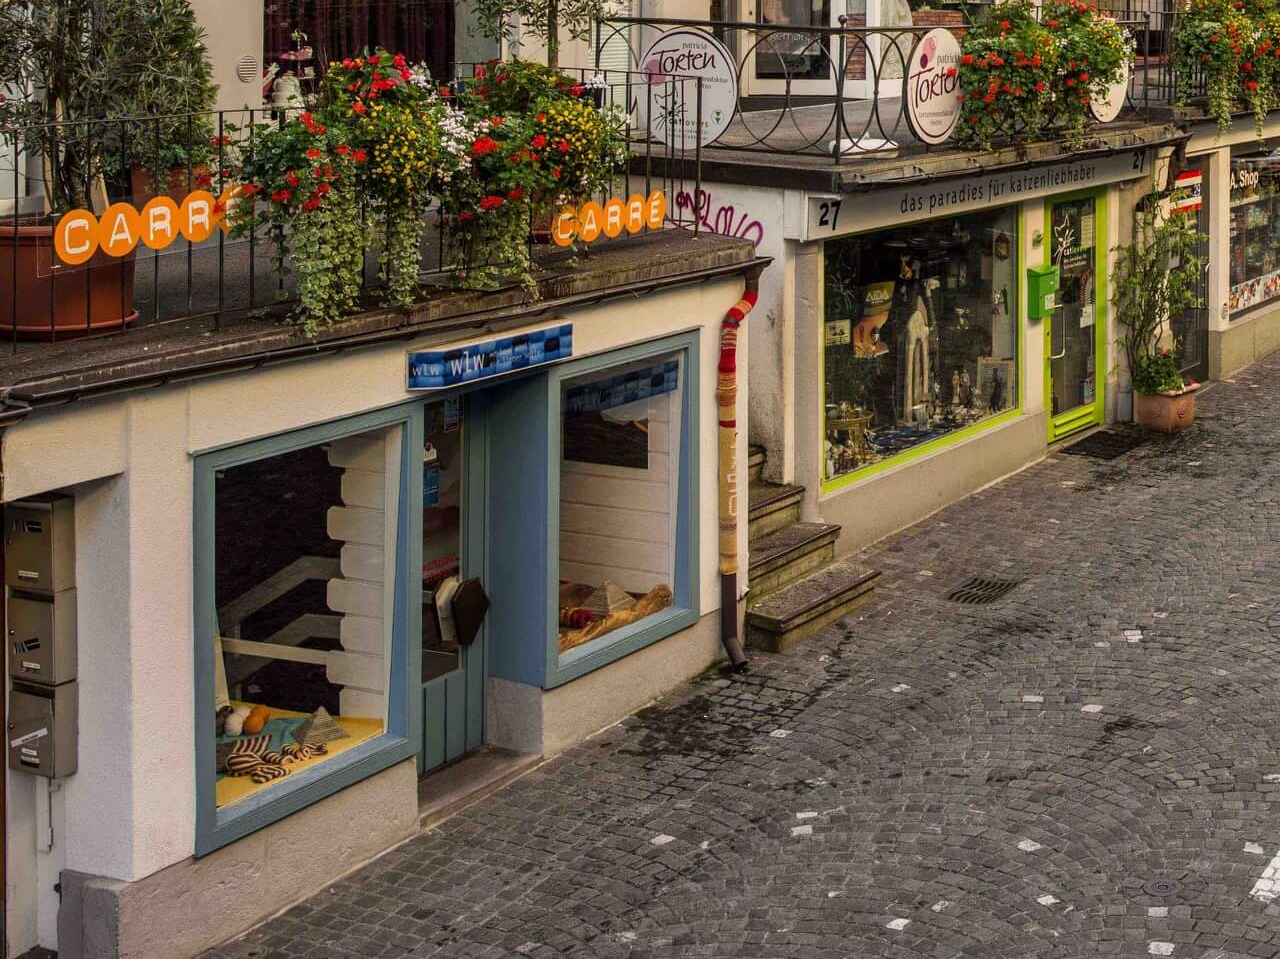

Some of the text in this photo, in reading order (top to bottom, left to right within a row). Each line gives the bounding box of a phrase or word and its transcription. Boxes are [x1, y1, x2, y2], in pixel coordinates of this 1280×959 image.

[652, 48, 716, 74] Torten
[910, 66, 963, 108] Torten
[1132, 149, 1146, 174] 27
[900, 164, 1097, 214] das paradies für katzenliebhaber
[1239, 169, 1259, 189] Shop
[64, 186, 242, 255] CARRÉ
[557, 190, 662, 239] CARRÉ
[819, 200, 842, 231] 27
[865, 290, 890, 303] AIDA
[412, 351, 485, 377] wlw wlw
